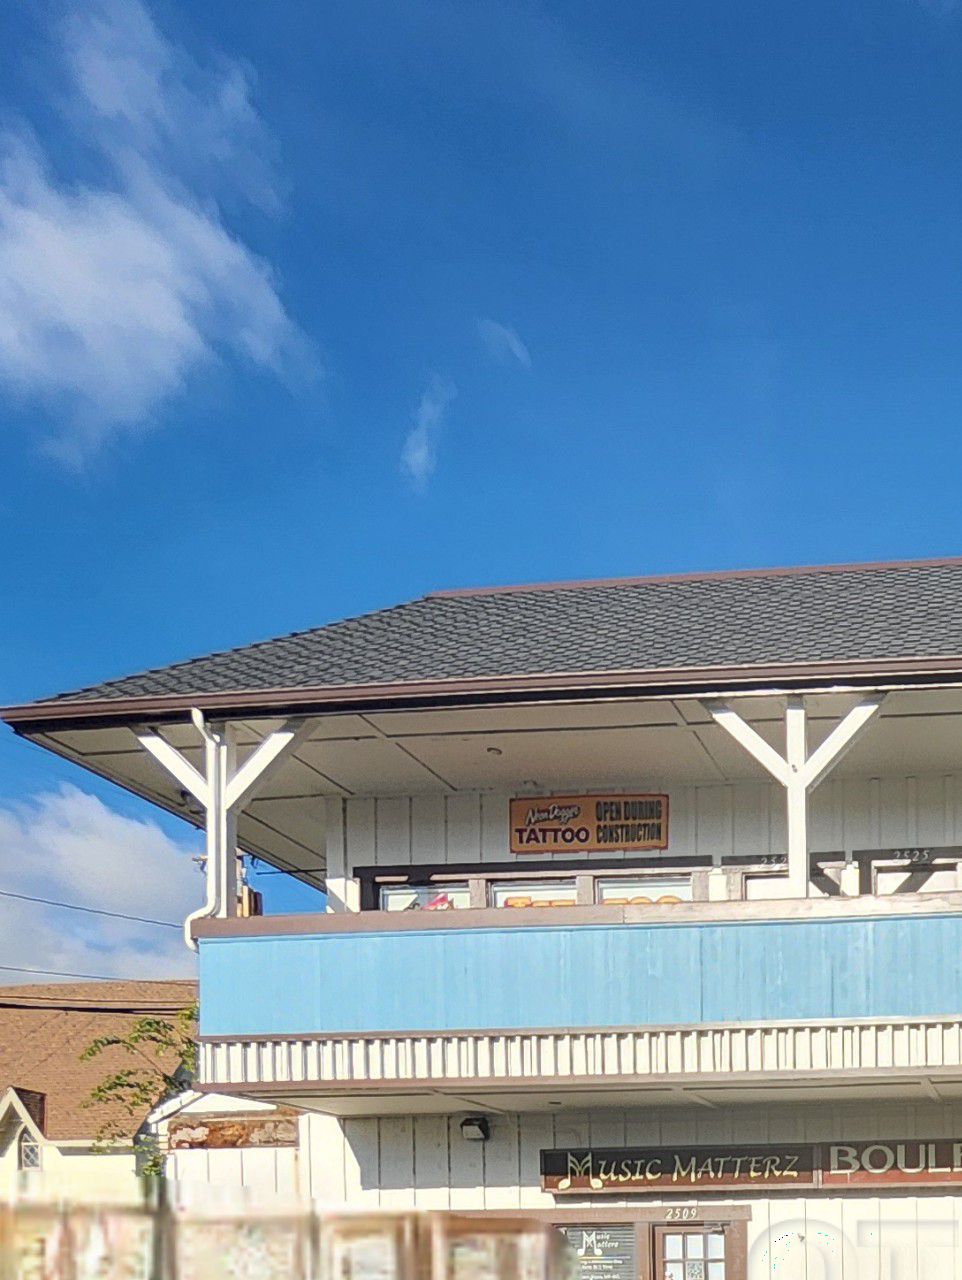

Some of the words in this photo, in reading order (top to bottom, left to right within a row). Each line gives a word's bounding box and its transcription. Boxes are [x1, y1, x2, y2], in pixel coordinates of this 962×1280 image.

[596, 800, 622, 822] OPEN
[623, 799, 662, 820] DURING
[515, 827, 590, 844] TATTOO
[596, 823, 662, 844] CONSTRUCTION
[558, 1152, 663, 1191] MUSIC
[672, 1153, 799, 1183] MATTERZ
[665, 1207, 698, 1220] 2509
